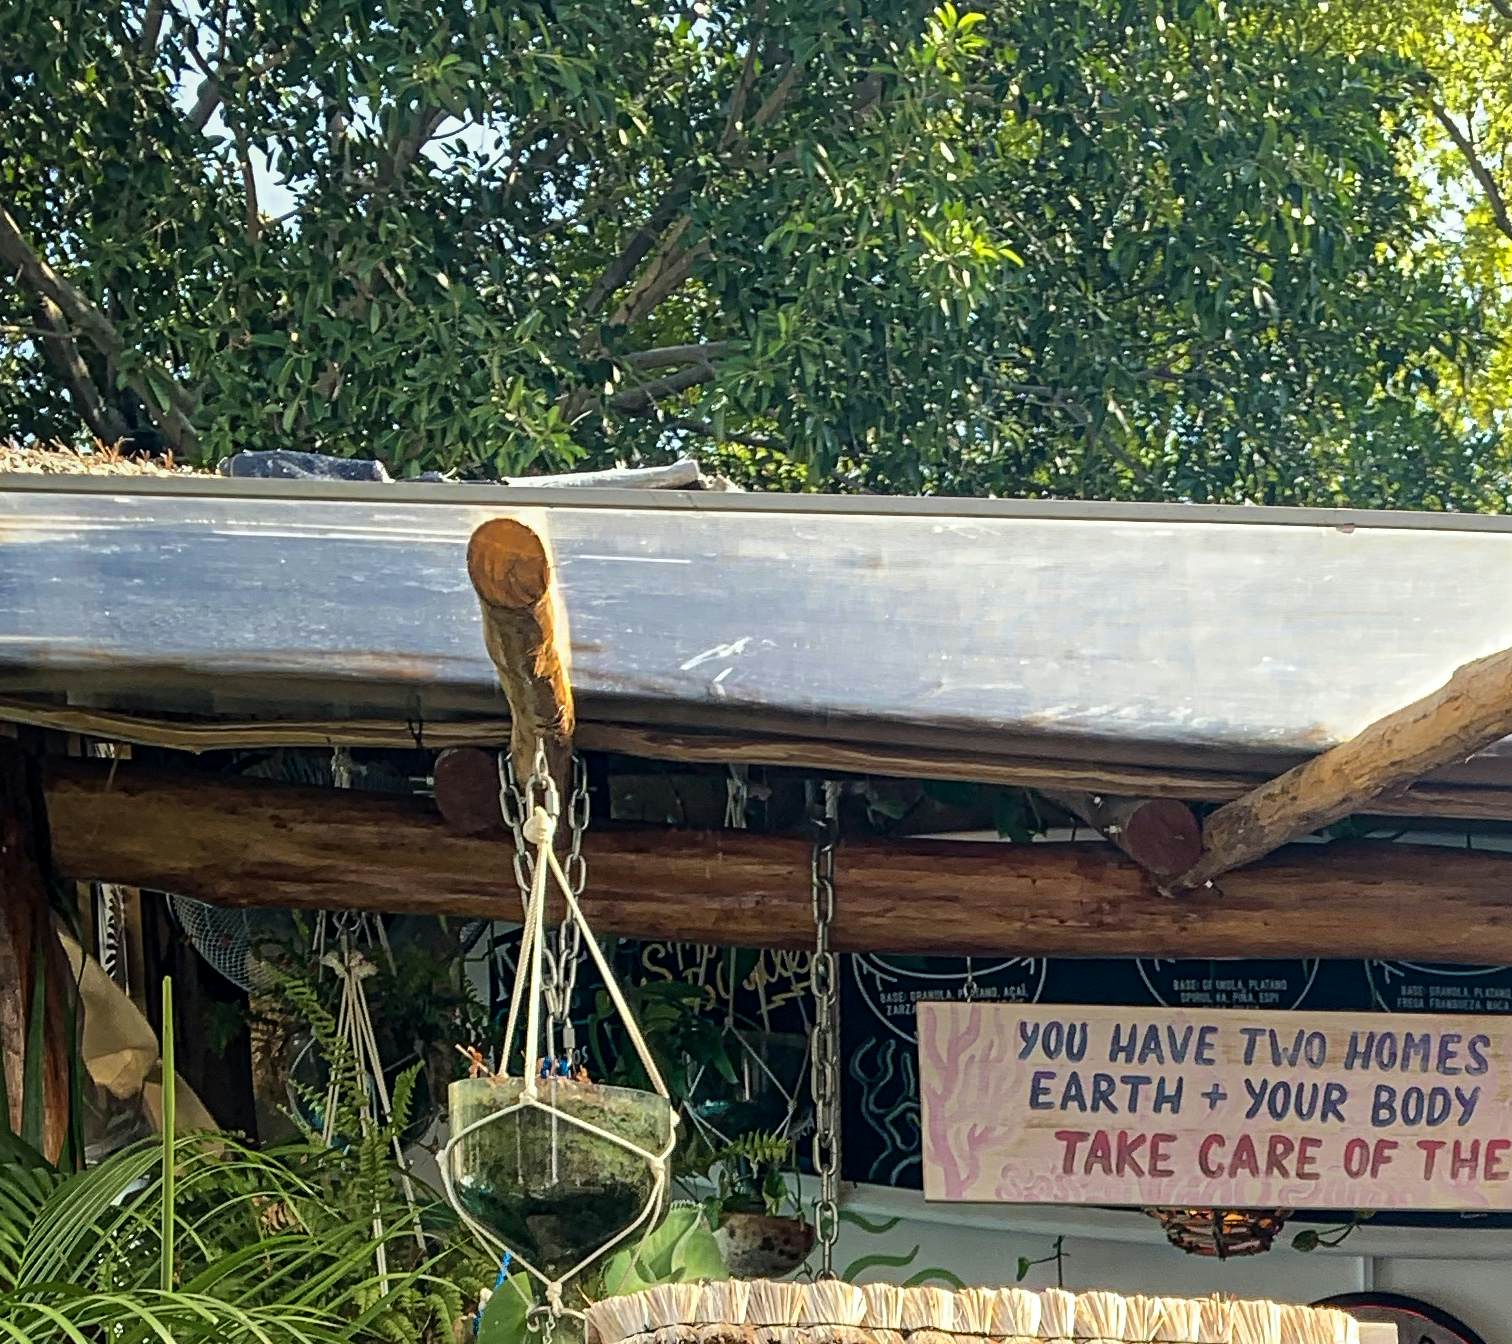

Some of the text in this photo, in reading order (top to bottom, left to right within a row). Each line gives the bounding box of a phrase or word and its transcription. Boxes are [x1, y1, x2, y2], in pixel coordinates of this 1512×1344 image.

[1018, 1021, 1491, 1076] YOU HAVE TWO HOMES
[1029, 1071, 1481, 1127] EARTH + YOUR BODY
[1055, 1131, 1178, 1179] TAKE
[1198, 1133, 1321, 1181] CARE
[1345, 1136, 1404, 1181] OF
